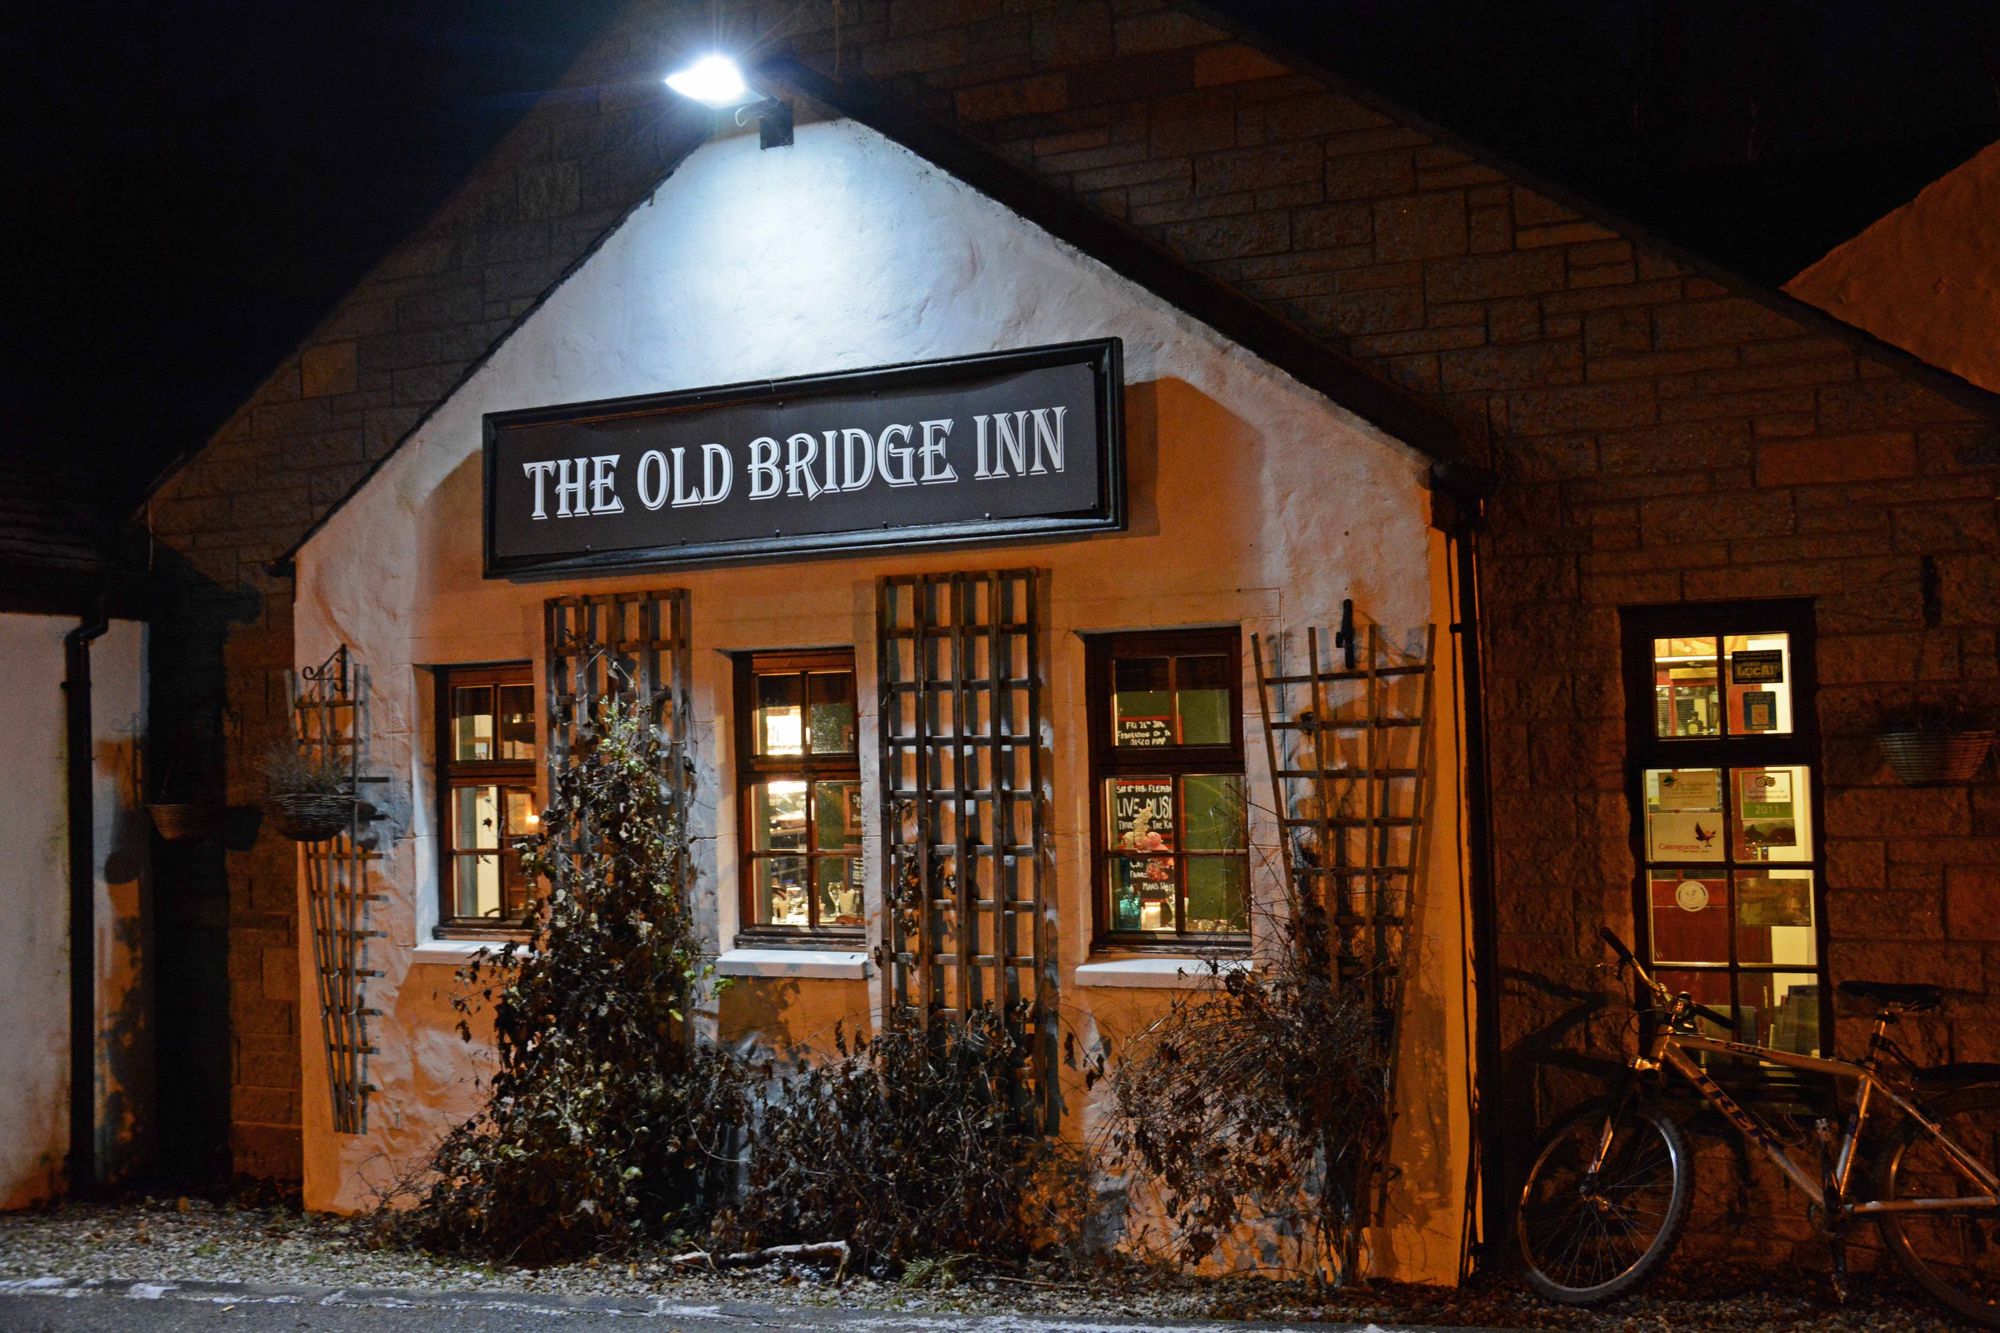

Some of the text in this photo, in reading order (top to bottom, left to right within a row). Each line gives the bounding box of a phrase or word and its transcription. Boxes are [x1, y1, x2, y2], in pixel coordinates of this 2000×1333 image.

[523, 406, 1067, 520] THE OLD BRIDGE INN
[1117, 795, 1172, 819] LIVE MUSI
[1754, 805, 1779, 815] 2011
